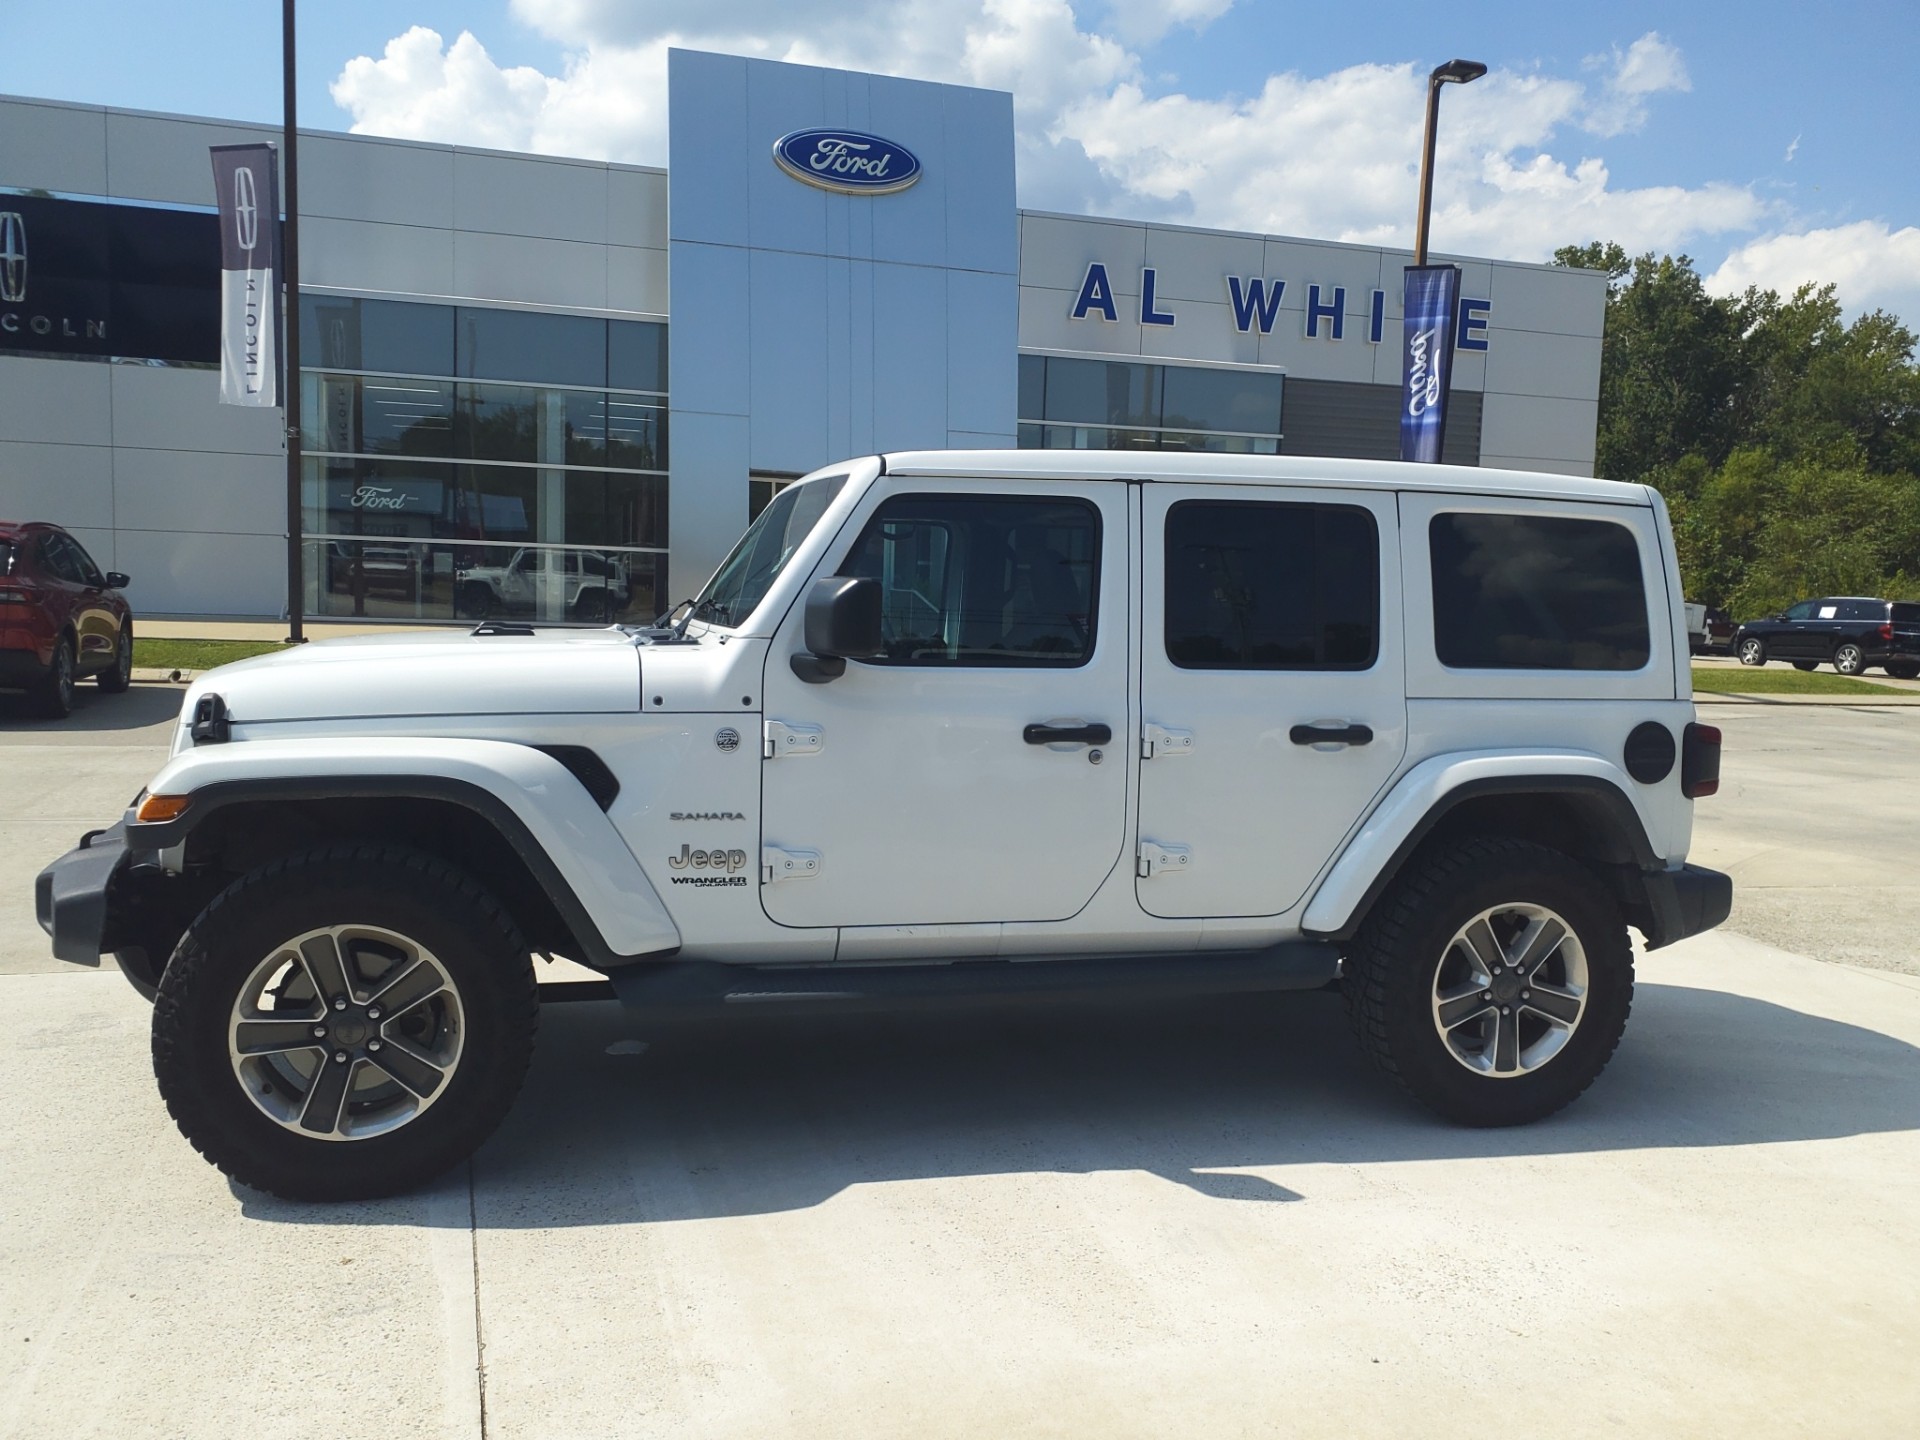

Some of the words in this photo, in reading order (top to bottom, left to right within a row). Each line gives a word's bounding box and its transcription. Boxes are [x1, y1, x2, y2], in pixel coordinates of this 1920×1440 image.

[810, 139, 891, 176] Ford
[1070, 262, 1177, 328] AL
[1225, 275, 1493, 352] WHIE
[350, 486, 406, 509] Ford
[669, 812, 746, 821] SAHARA
[669, 844, 747, 873] Jeep
